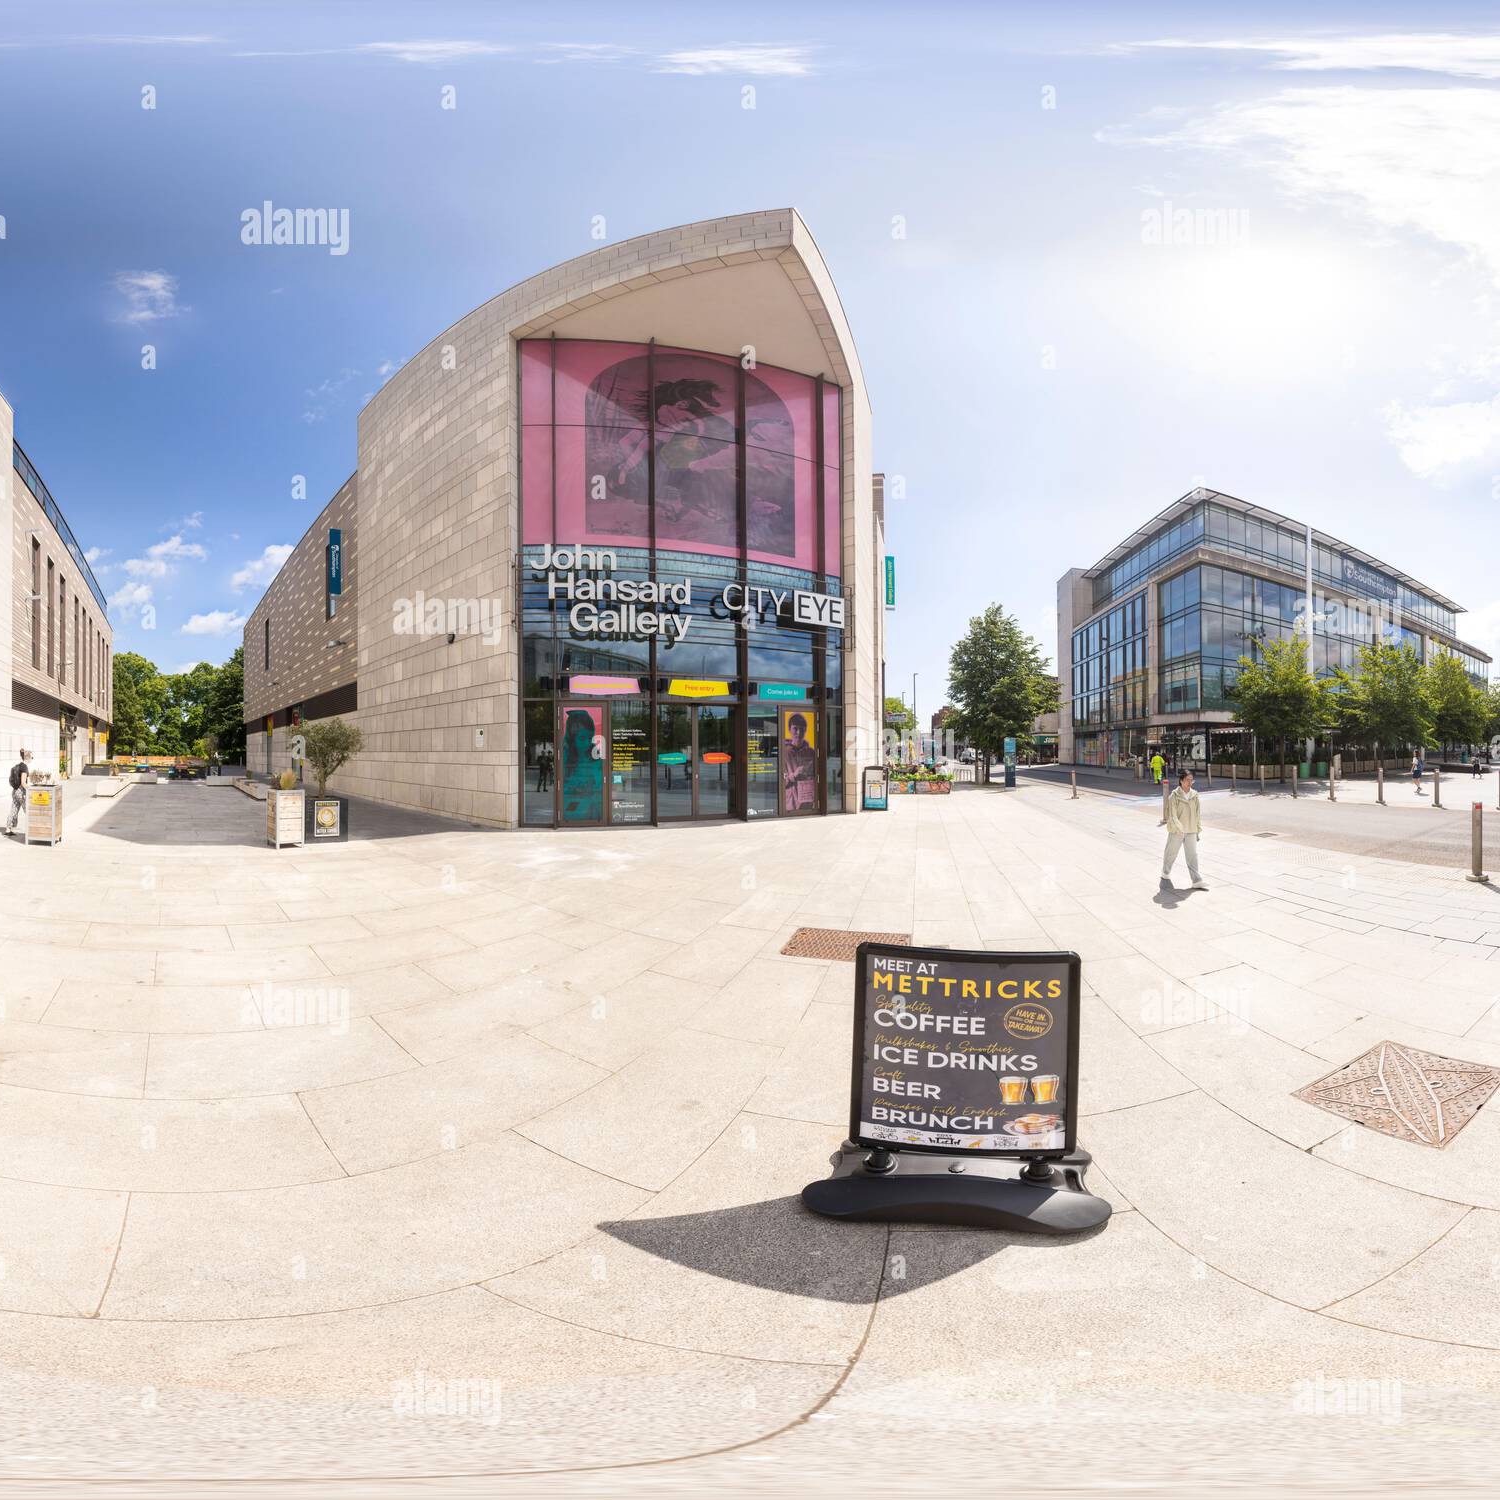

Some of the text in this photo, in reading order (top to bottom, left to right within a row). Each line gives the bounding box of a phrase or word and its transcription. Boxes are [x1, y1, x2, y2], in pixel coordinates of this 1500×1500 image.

[530, 544, 617, 571] John
[548, 571, 691, 605] Hansard
[1354, 570, 1397, 599] Southampton
[722, 584, 842, 625] CITY EYE
[570, 602, 692, 641] Gallery
[873, 958, 938, 976] MEET AT
[872, 971, 1061, 999] METTRICKS
[874, 1008, 986, 1036] COFFEE
[1008, 1020, 1046, 1034] TAKEAWAY
[1016, 1009, 1037, 1020] HAVE
[875, 1033, 938, 1051] Milkshakes
[958, 1040, 1014, 1054] Smoothies
[873, 1044, 1038, 1072] ICE DRINKS
[873, 1066, 906, 1081] Craft
[872, 1076, 941, 1100] BEER
[872, 1106, 994, 1130] BRUNCH
[932, 1104, 956, 1116] Full
[962, 1106, 1010, 1118] English
